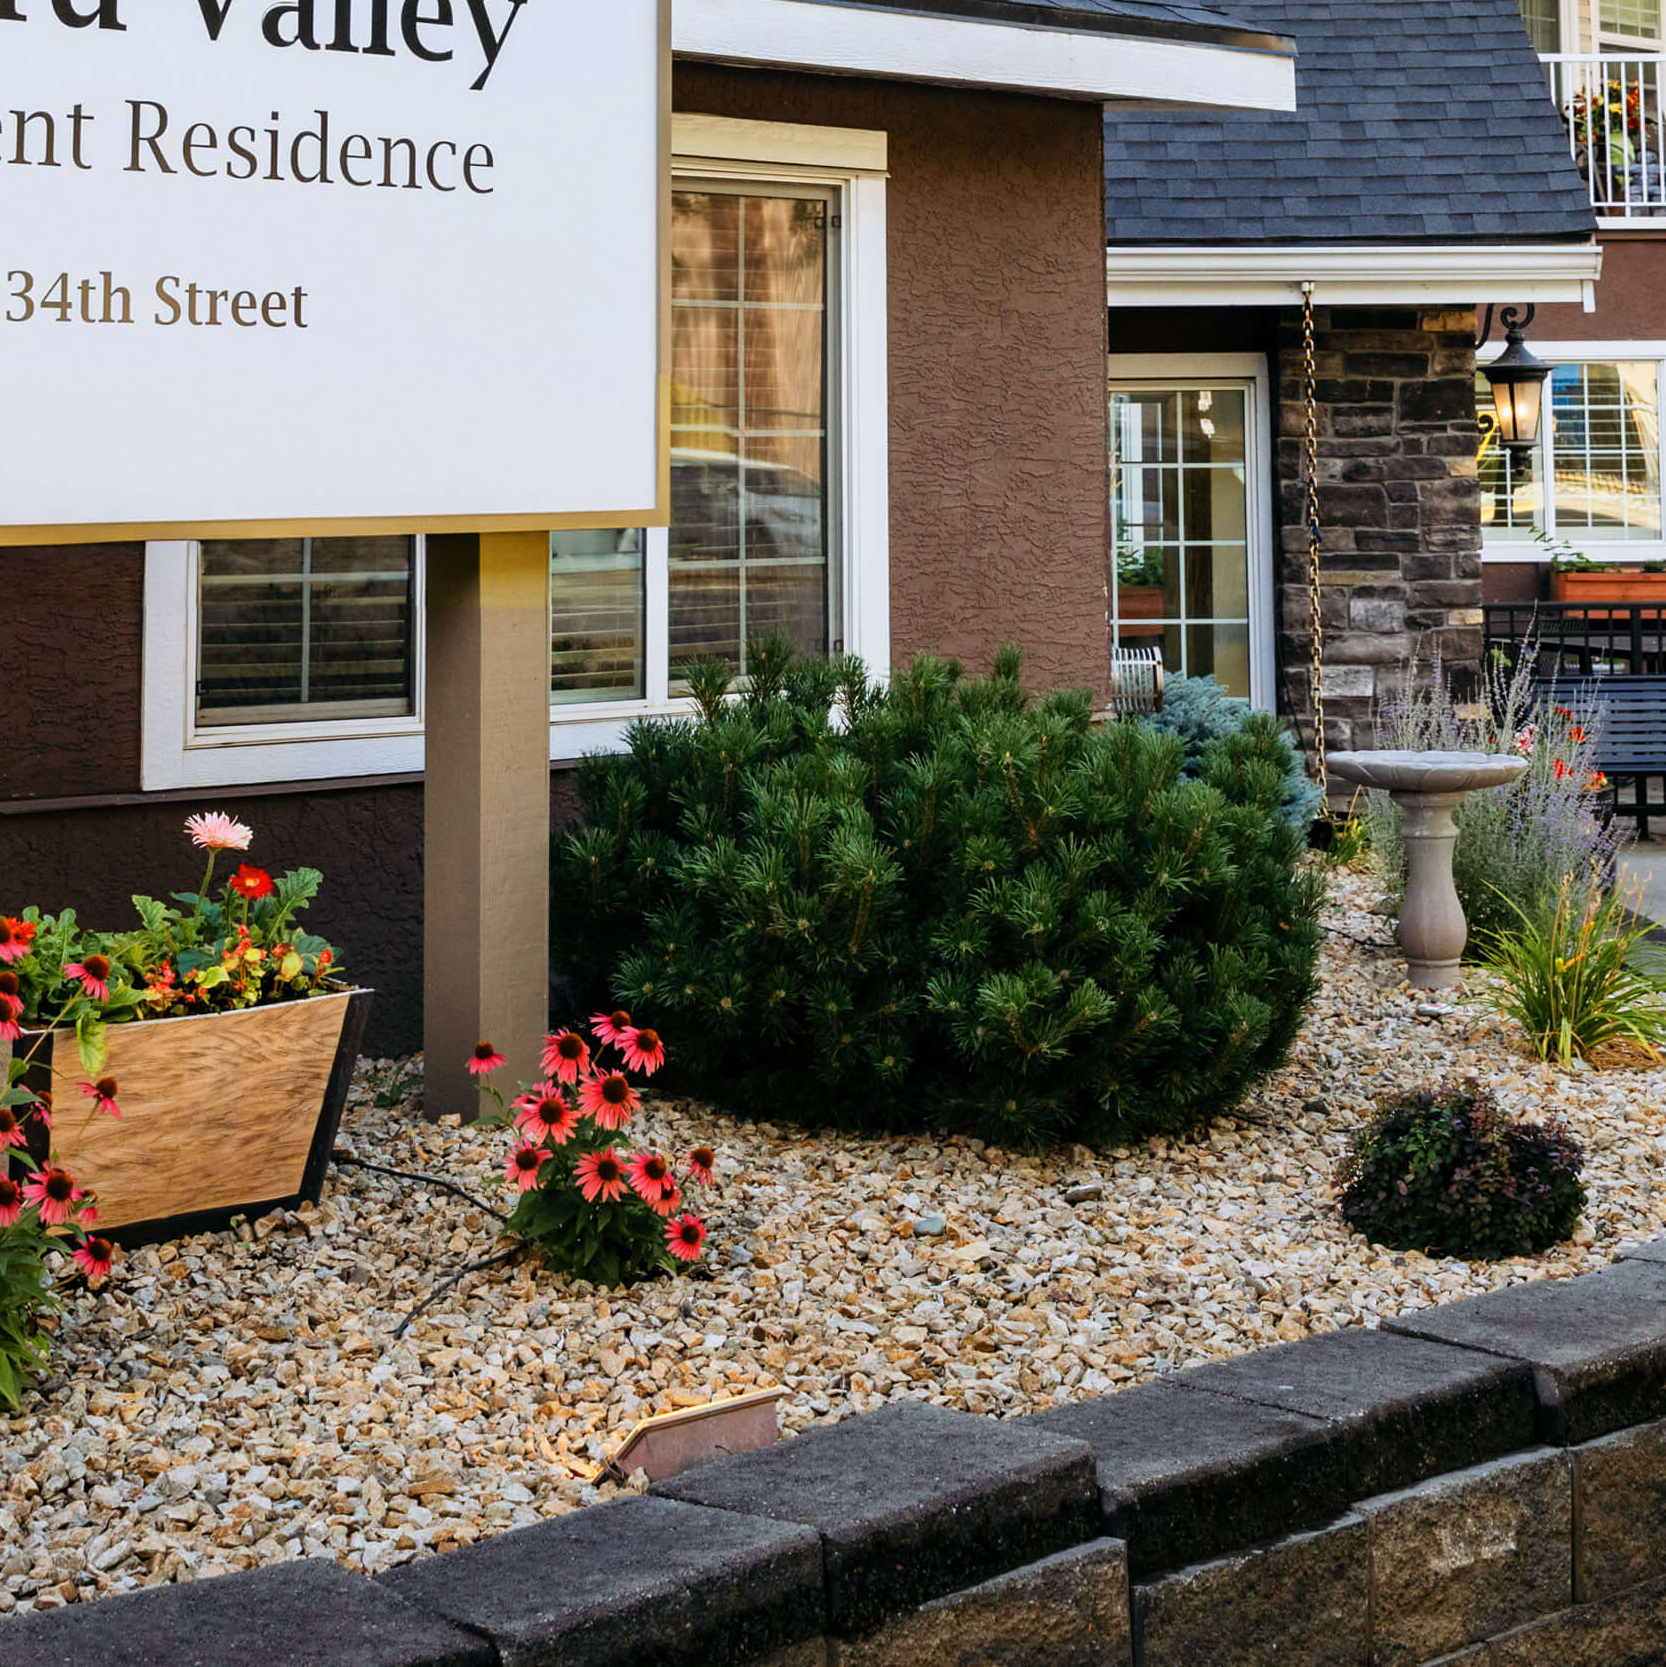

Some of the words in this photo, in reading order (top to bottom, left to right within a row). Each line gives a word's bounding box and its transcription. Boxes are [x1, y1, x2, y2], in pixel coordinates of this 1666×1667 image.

[122, 99, 494, 195] Residence
[5, 270, 135, 324] 34th
[154, 275, 309, 329] Street
